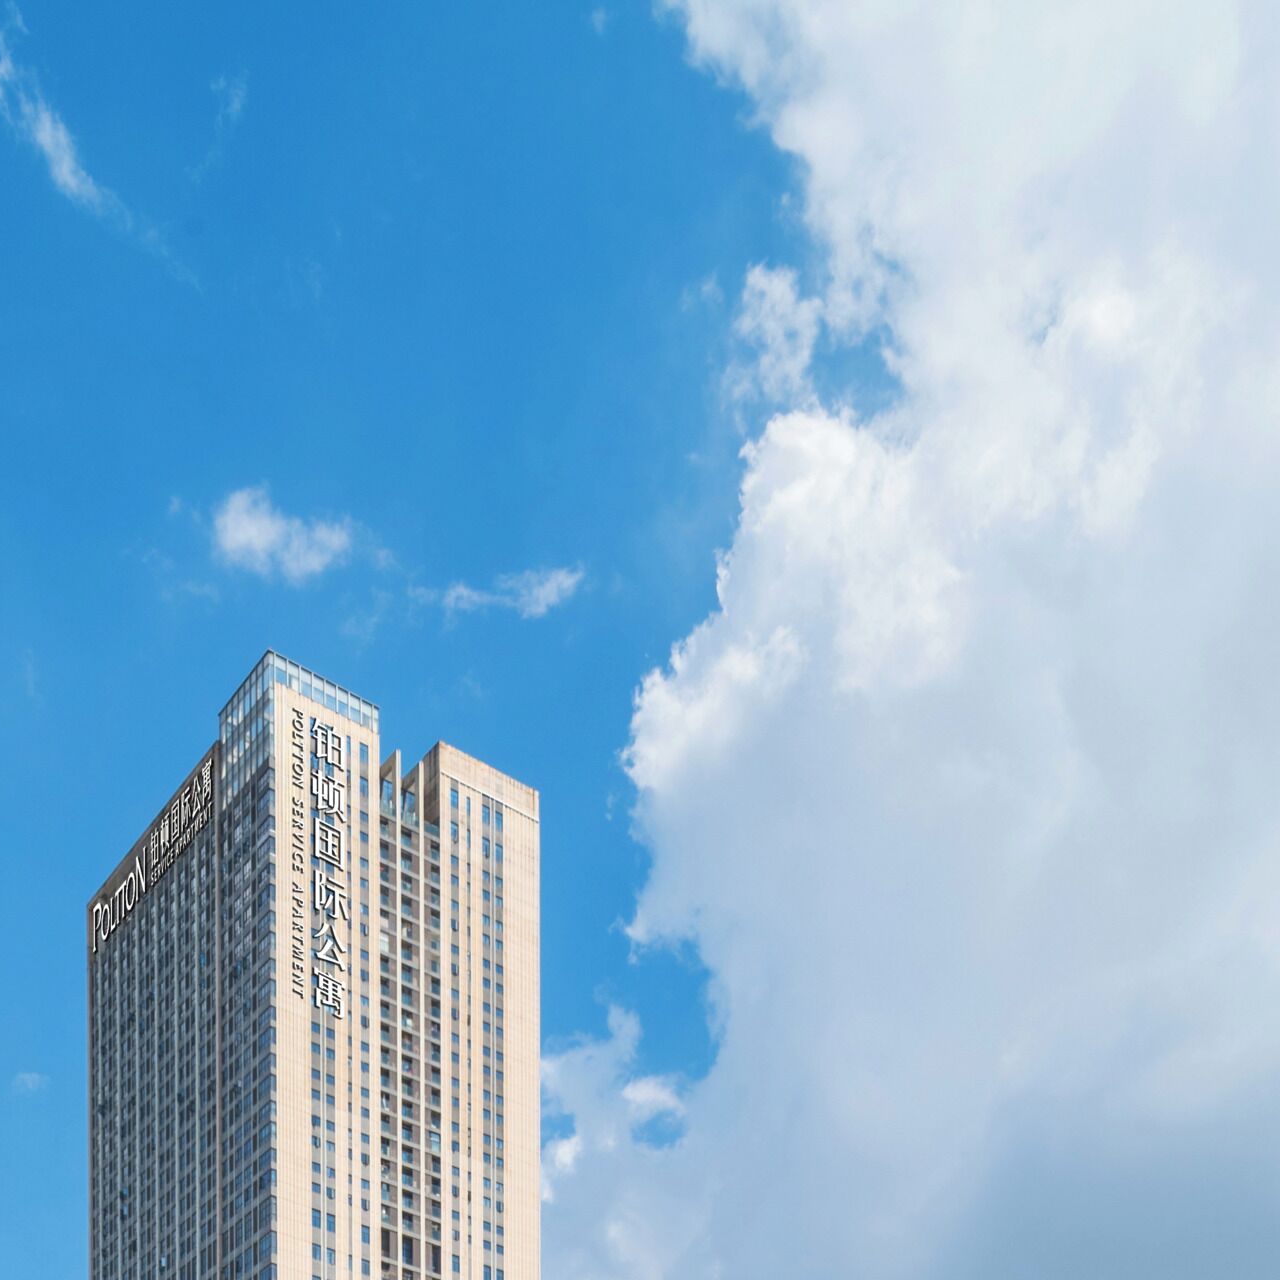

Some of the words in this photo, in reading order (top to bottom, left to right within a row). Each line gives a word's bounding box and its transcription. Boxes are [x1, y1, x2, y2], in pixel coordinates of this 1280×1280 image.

[150, 757, 213, 869] 铂顿国际公寓
[150, 848, 174, 886] SERVICE
[175, 801, 213, 857] APARTMENT
[291, 797, 304, 874] SERVICE
[310, 717, 350, 1019] 铂顿国际公寓
[291, 881, 304, 1000] APARTMENT
